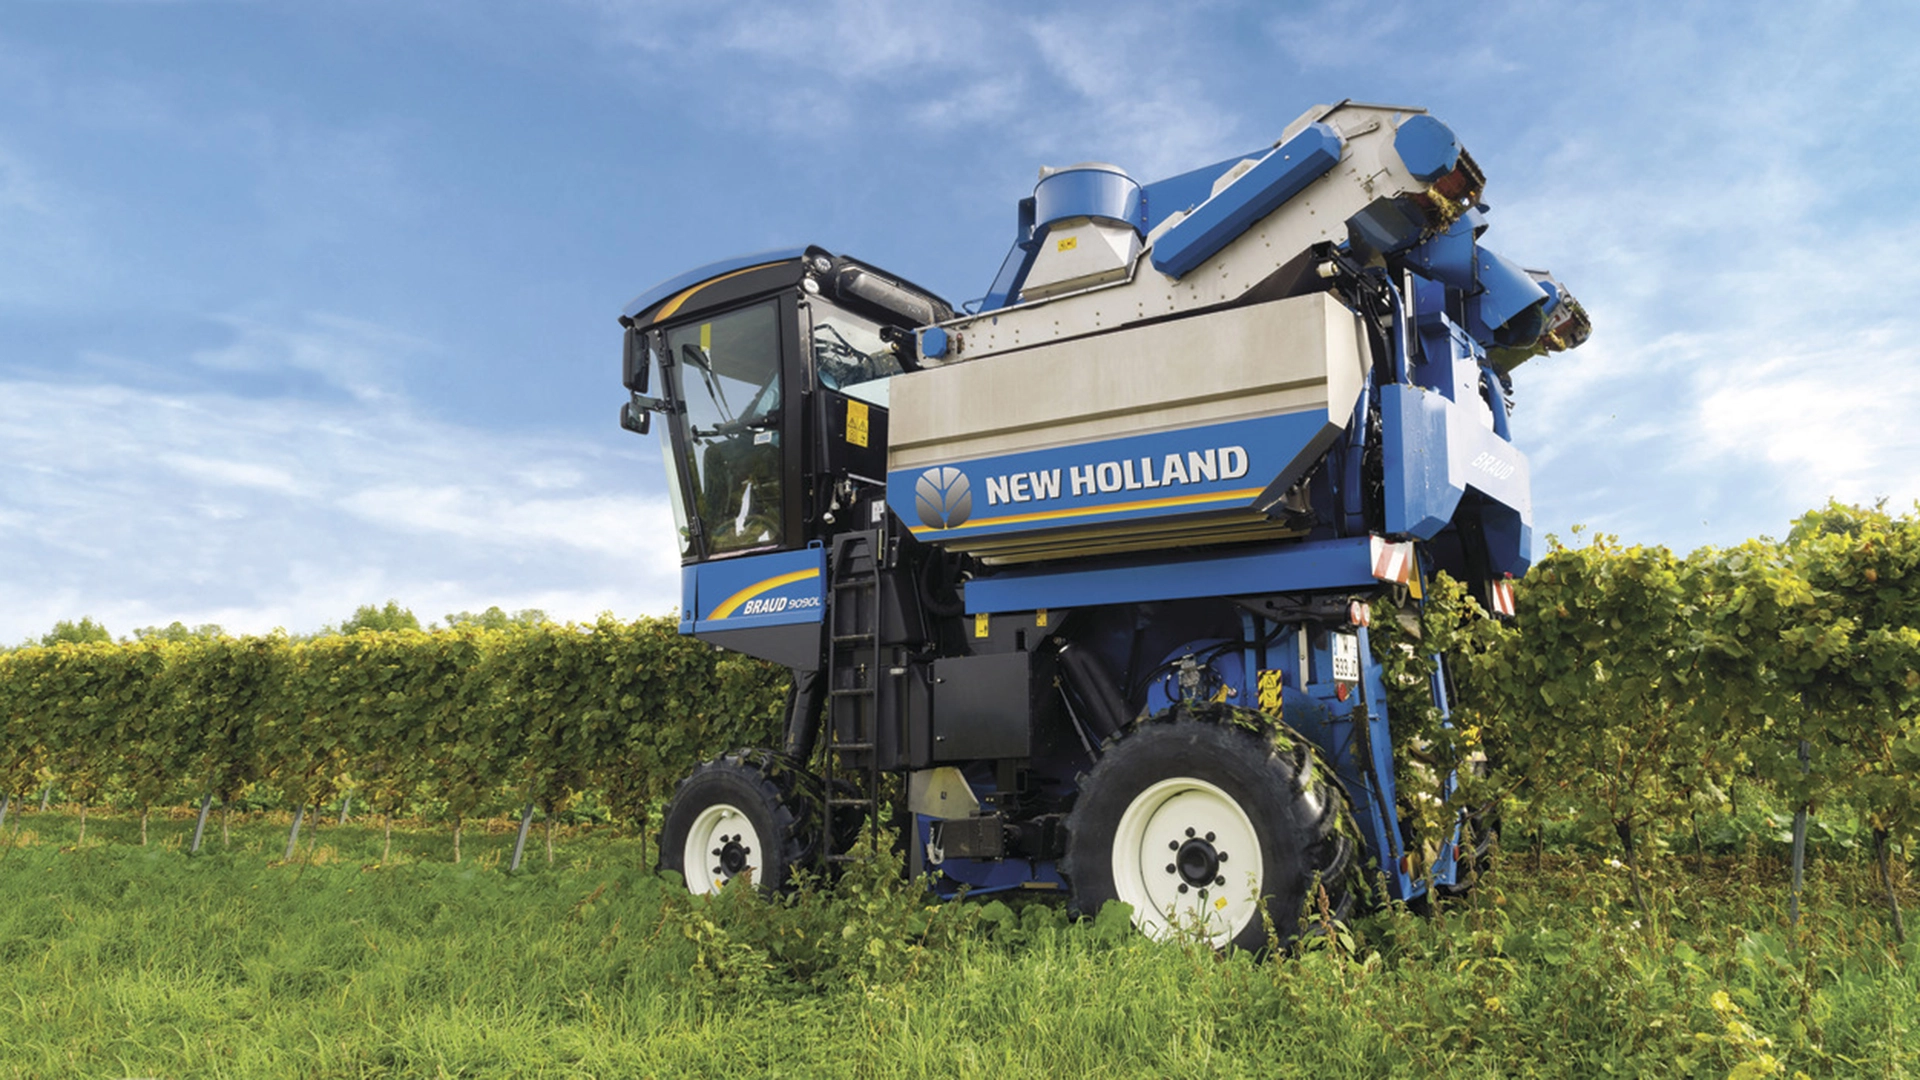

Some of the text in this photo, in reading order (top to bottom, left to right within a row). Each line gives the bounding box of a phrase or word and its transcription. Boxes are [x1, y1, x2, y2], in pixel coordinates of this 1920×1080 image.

[985, 445, 1250, 506] NEW HOLLAND
[1471, 451, 1515, 480] BRAUD
[743, 596, 821, 615] BRAUD 9090L
